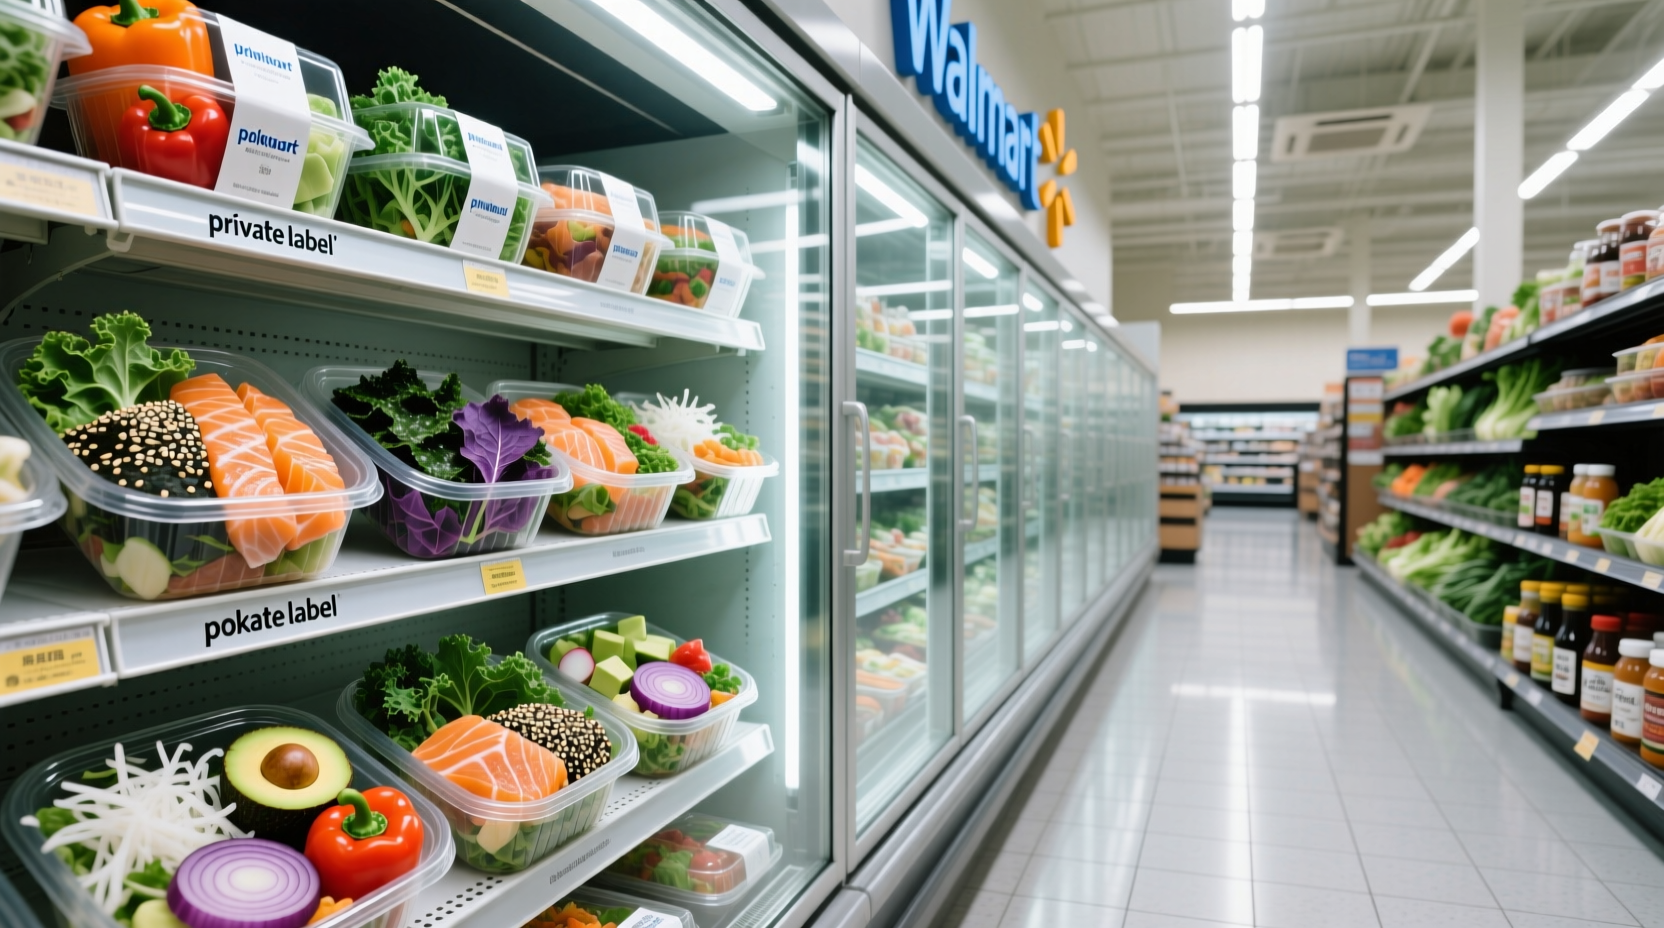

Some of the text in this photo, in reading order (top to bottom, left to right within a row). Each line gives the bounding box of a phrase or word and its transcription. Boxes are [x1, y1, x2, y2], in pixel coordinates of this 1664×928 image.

[891, 0, 1042, 211] Walmart
[209, 213, 285, 245] private
[205, 607, 285, 647] pokate
